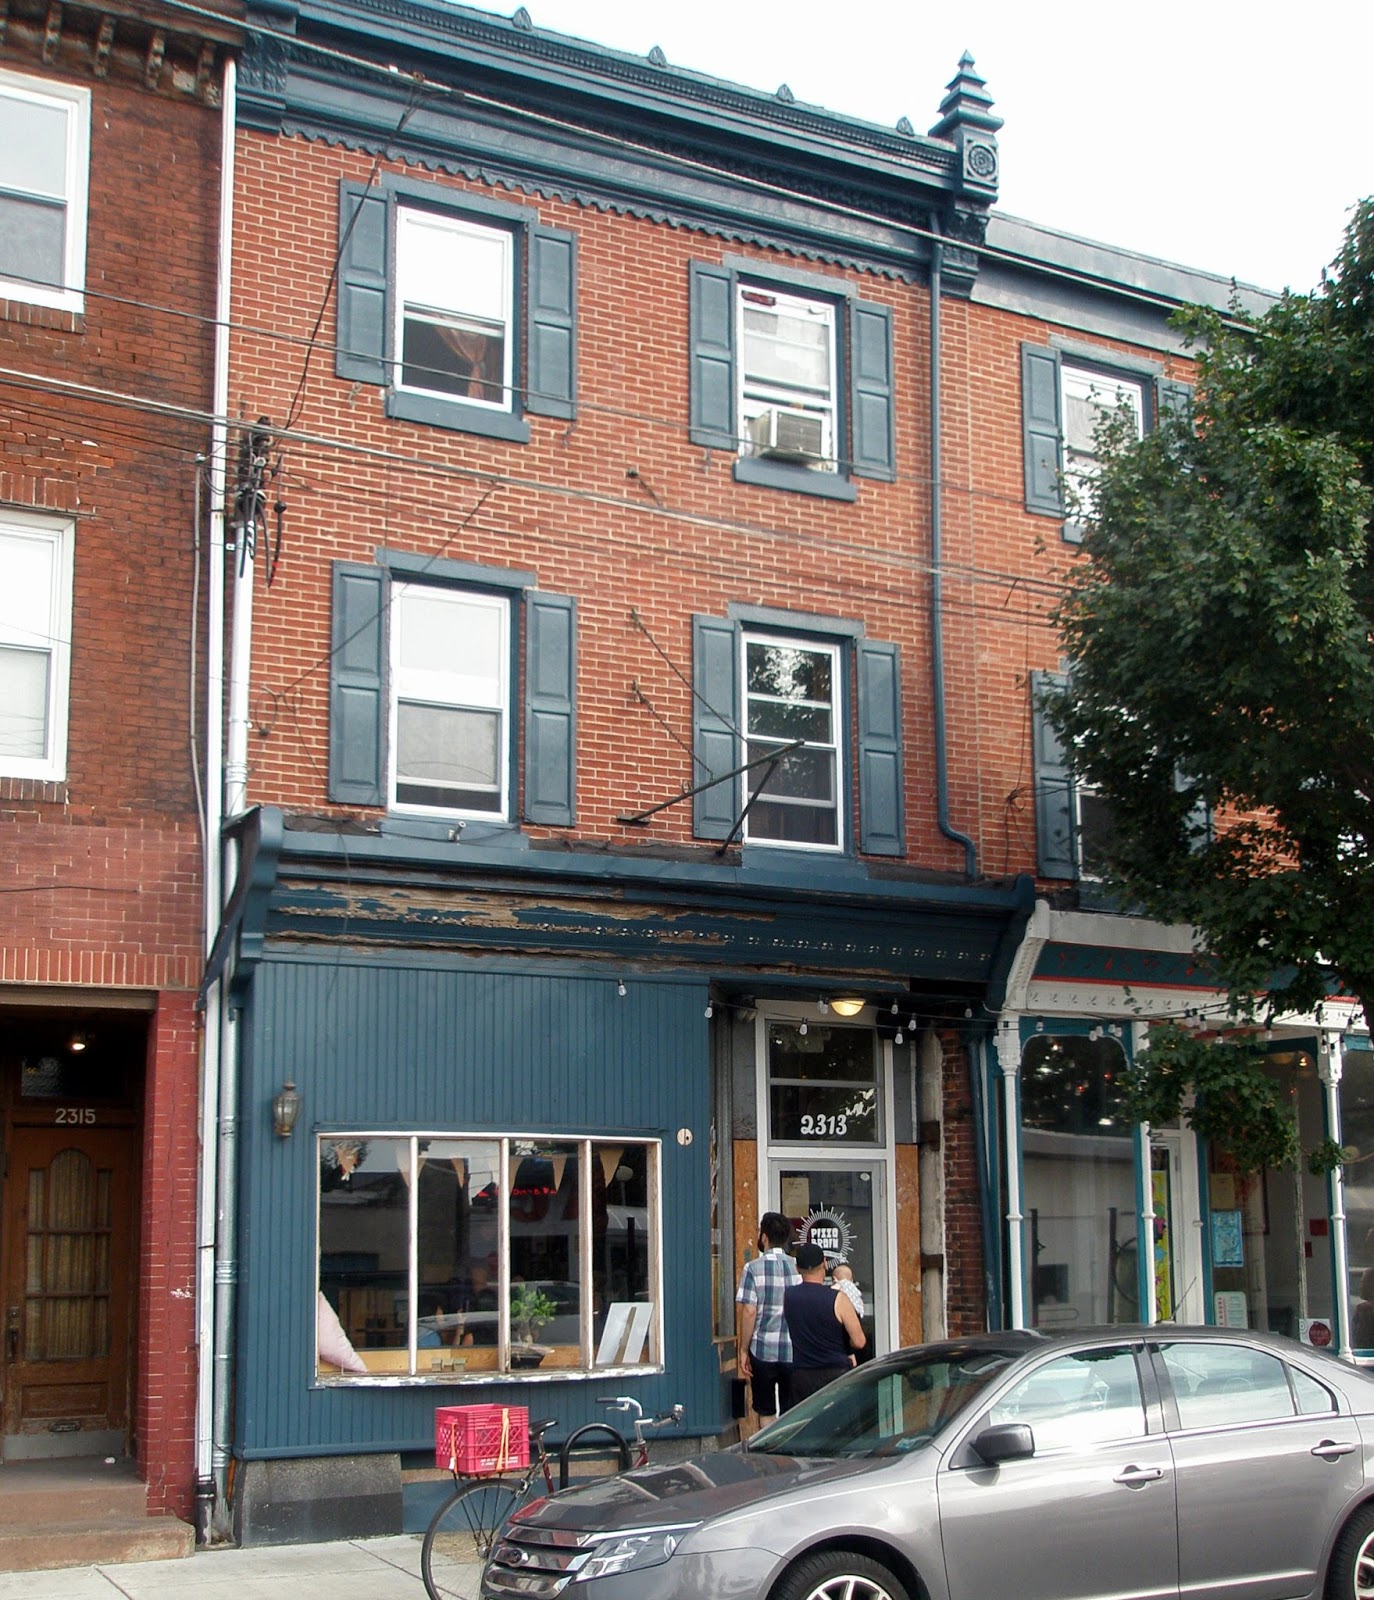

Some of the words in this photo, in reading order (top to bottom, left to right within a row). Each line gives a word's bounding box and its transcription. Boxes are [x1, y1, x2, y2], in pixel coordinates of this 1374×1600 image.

[55, 1108, 96, 1124] 2315
[800, 1114, 847, 1135] 2313
[811, 1227, 839, 1238] PIZZA
